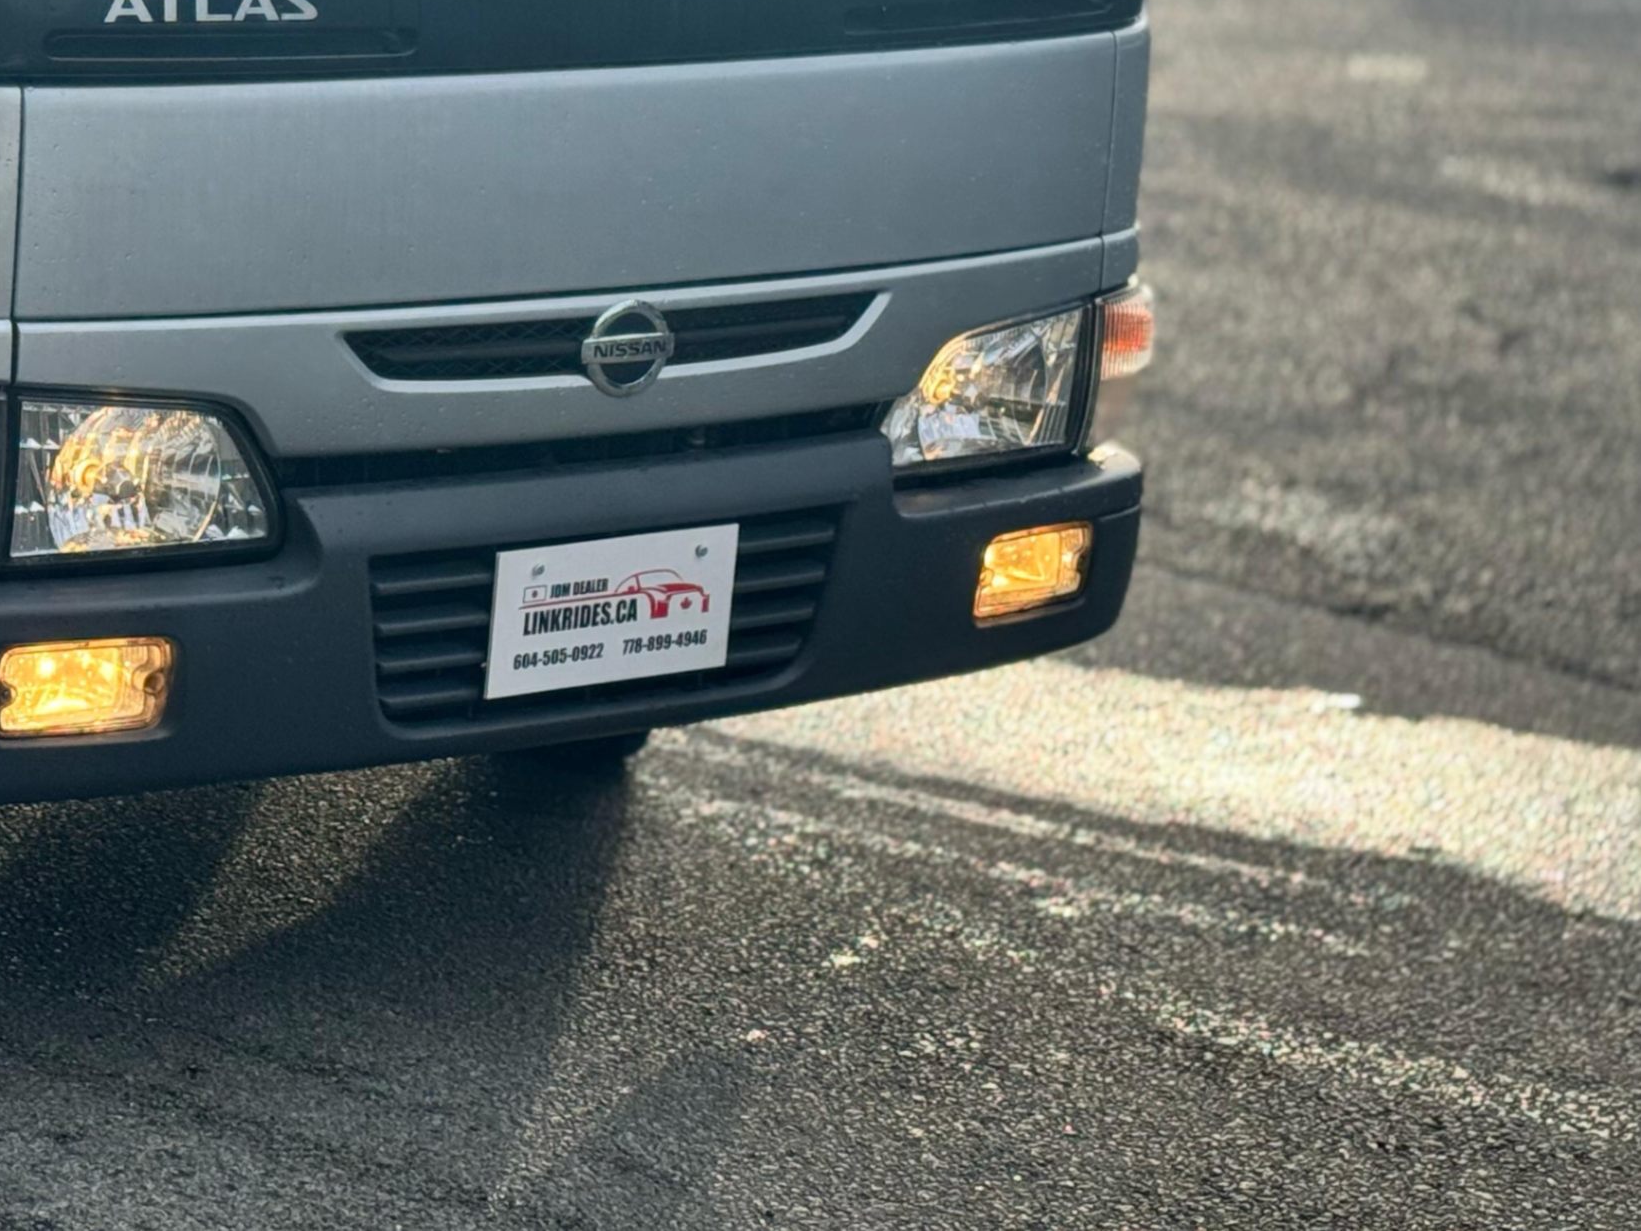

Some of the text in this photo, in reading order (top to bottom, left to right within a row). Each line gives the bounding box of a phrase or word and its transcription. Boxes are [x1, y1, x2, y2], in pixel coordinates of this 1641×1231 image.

[594, 339, 667, 359] NISSAN
[550, 578, 608, 599] JDM DEALER
[523, 598, 638, 636] LINKRIDES.CA
[513, 629, 708, 670] 604-505-0922 778-899-4946
